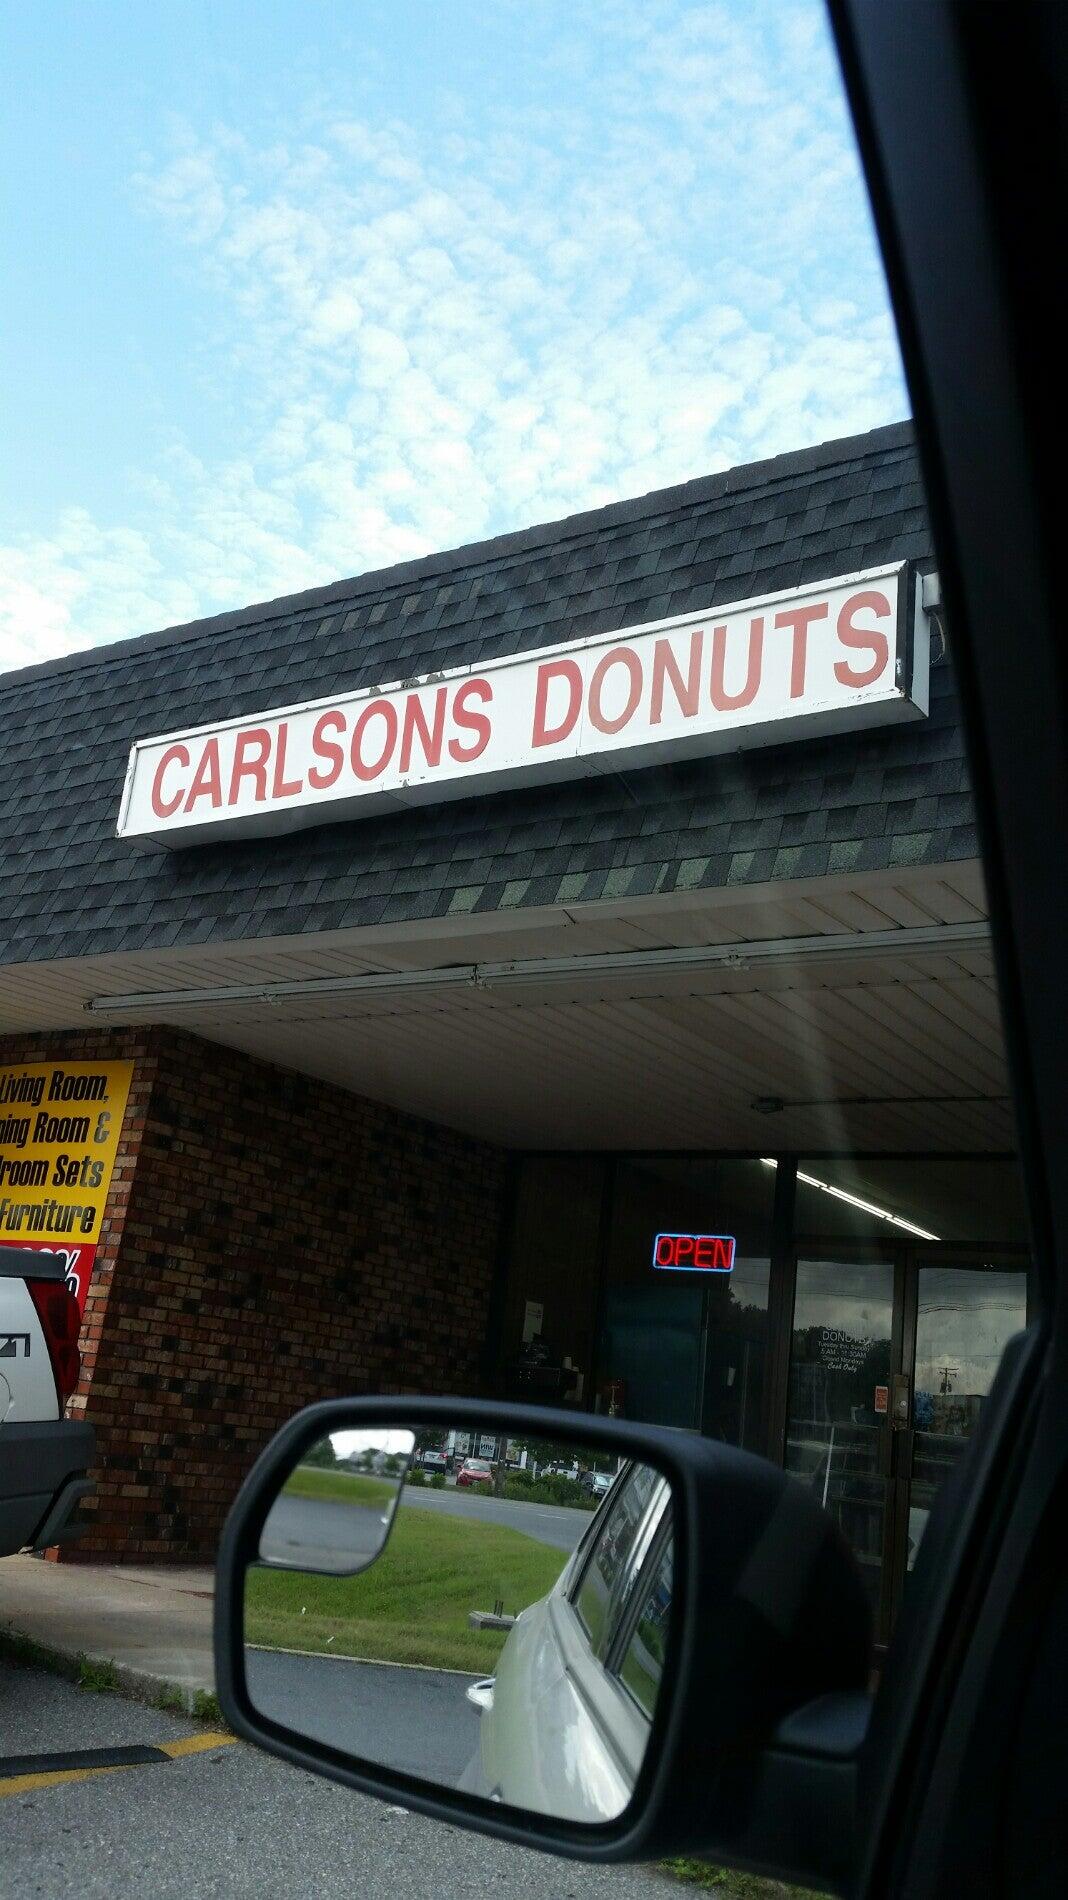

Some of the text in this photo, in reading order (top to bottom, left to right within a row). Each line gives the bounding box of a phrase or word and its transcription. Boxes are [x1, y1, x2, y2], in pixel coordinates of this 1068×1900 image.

[151, 590, 892, 819] CARLSONS DONUTS
[47, 1070, 108, 1103] Room,
[32, 1112, 90, 1143] Room
[0, 1154, 104, 1187] room Sets
[0, 1198, 96, 1233] Furniture
[657, 1236, 733, 1268] OPEN
